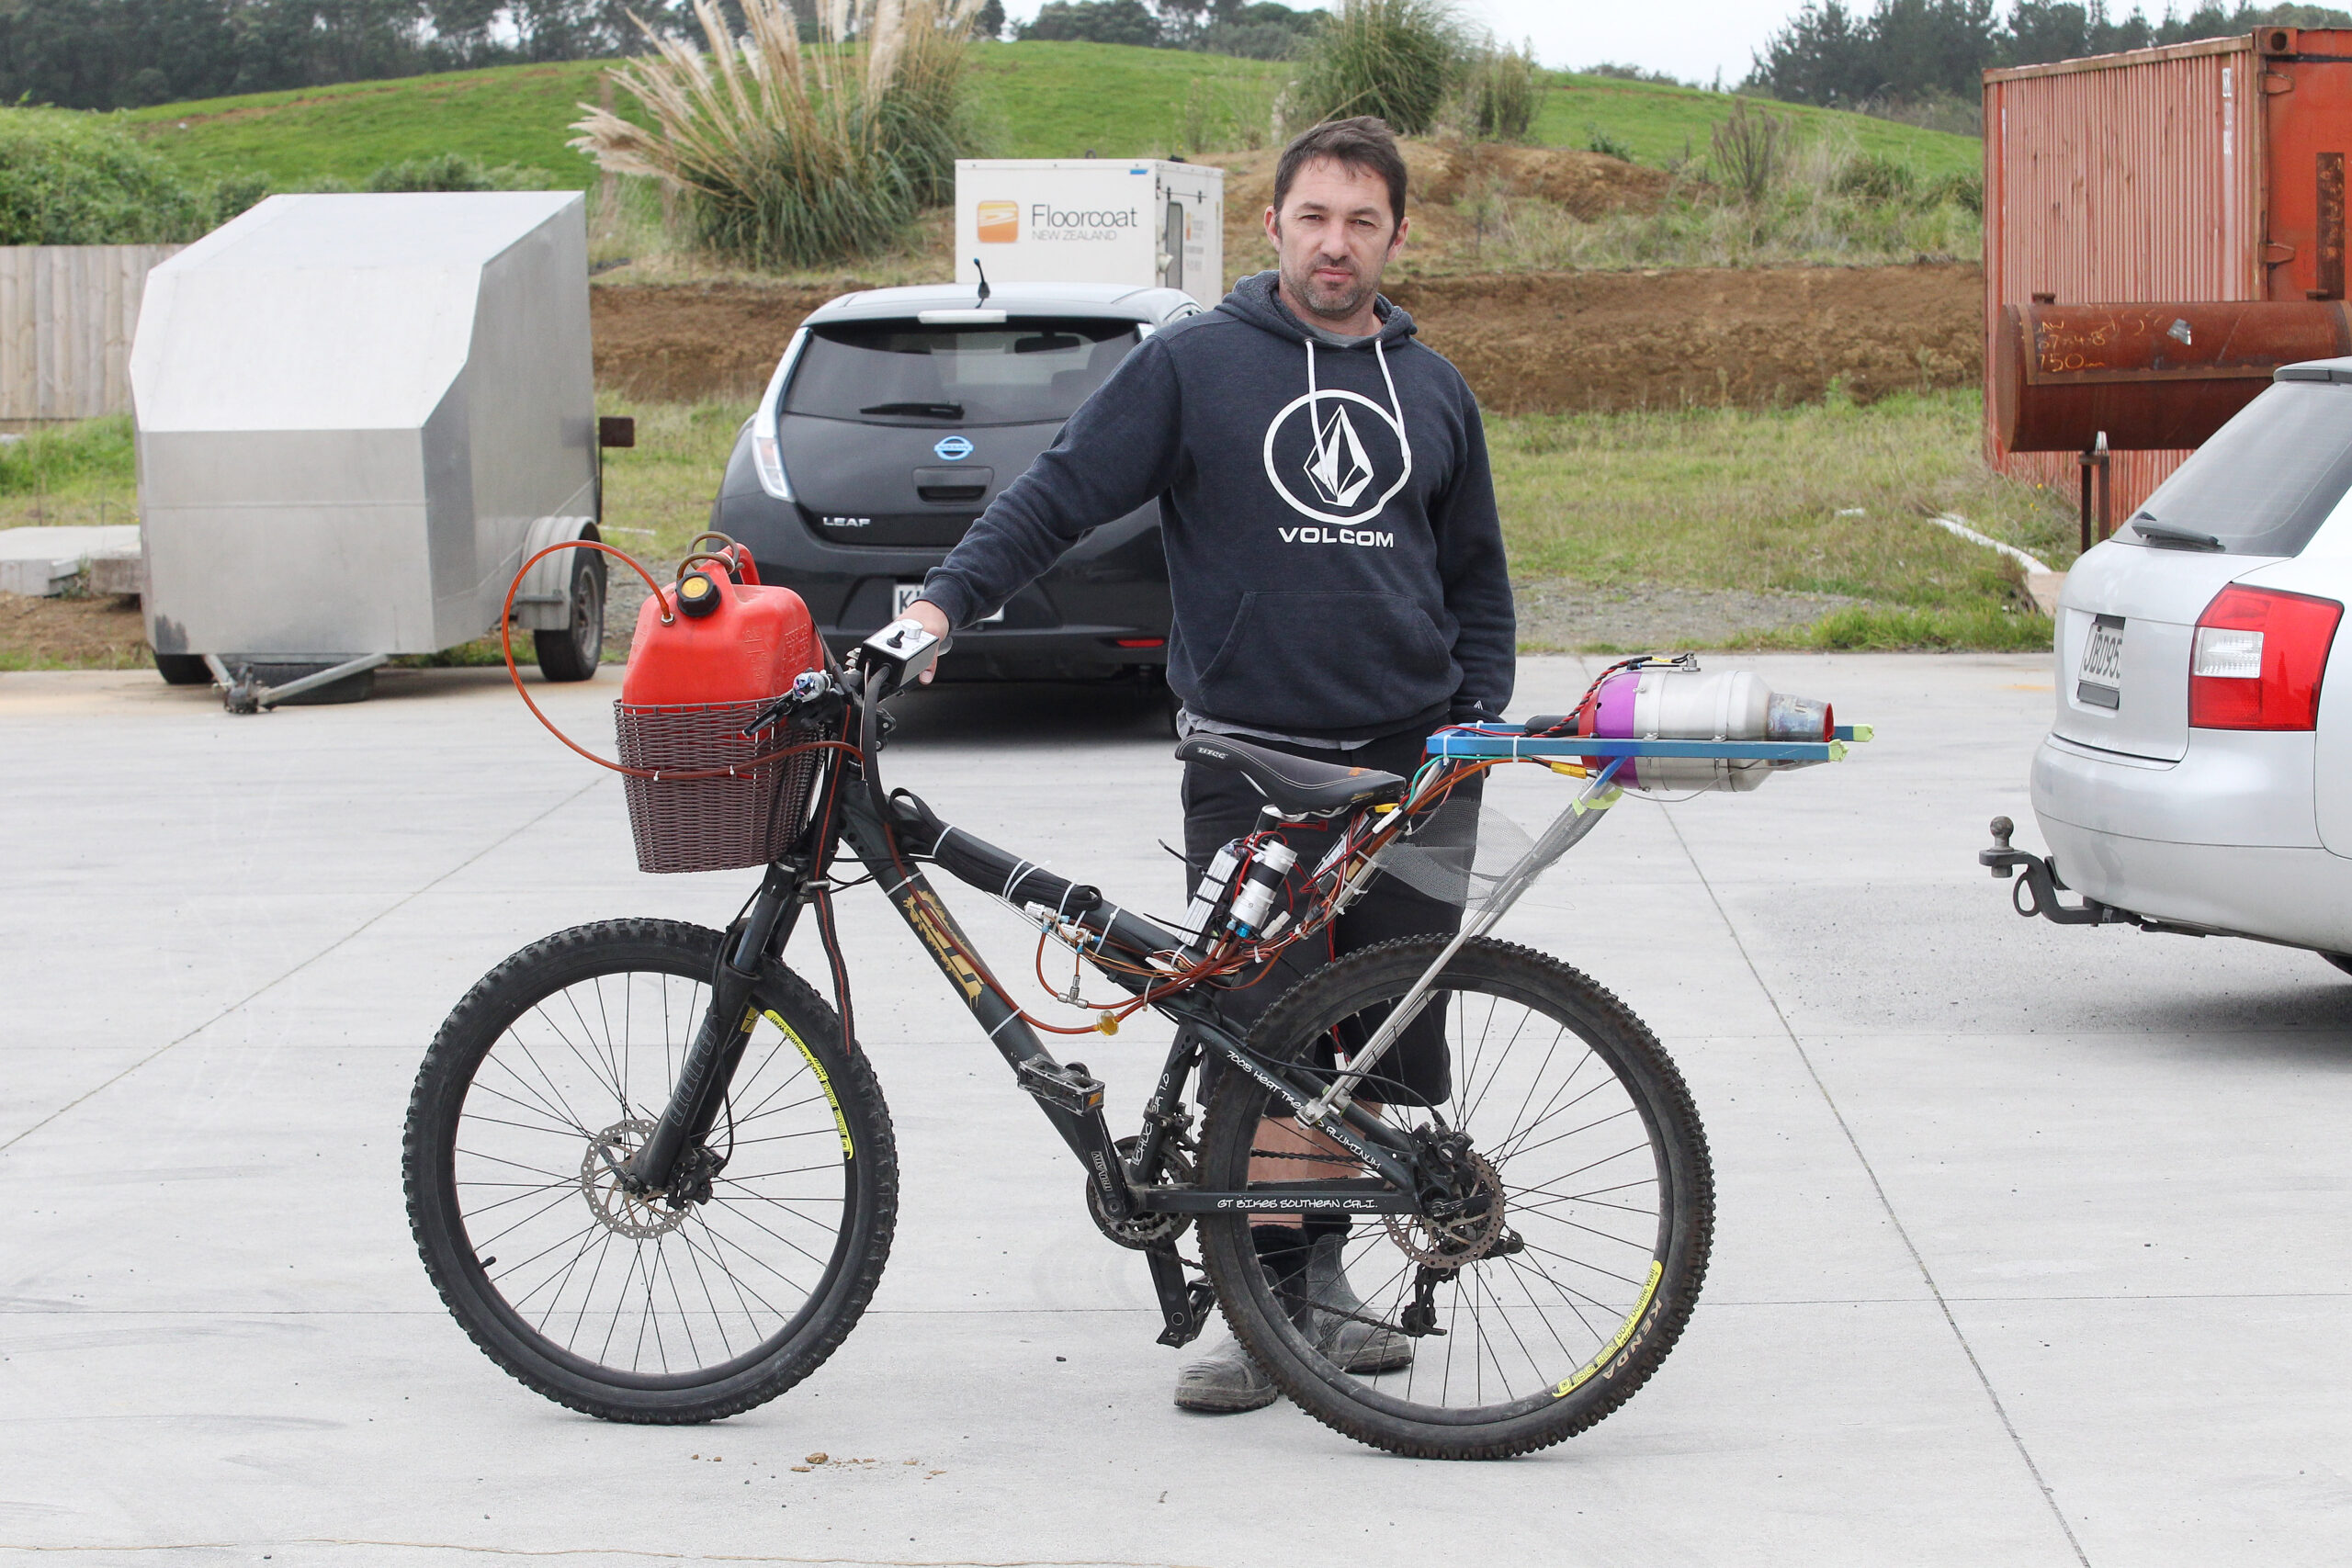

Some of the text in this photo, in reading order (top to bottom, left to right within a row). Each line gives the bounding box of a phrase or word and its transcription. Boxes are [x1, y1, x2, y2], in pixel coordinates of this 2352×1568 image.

[1031, 204, 1138, 228] Floorcoat
[1032, 230, 1117, 241] NEW ZEALAND
[823, 516, 871, 527] LEAF
[1277, 527, 1394, 547] VOLCOM
[769, 1016, 785, 1032] Wall
[785, 1031, 807, 1057] Double
[1227, 1050, 1254, 1073] 7005
[1326, 1126, 1382, 1170] ALUMINUM
[1217, 1199, 1234, 1209] GT
[1596, 1340, 1618, 1367] RIM
[1631, 1288, 1648, 1317] Double
[1645, 1268, 1657, 1288] Wall
[1601, 1297, 1663, 1381] KENDA
